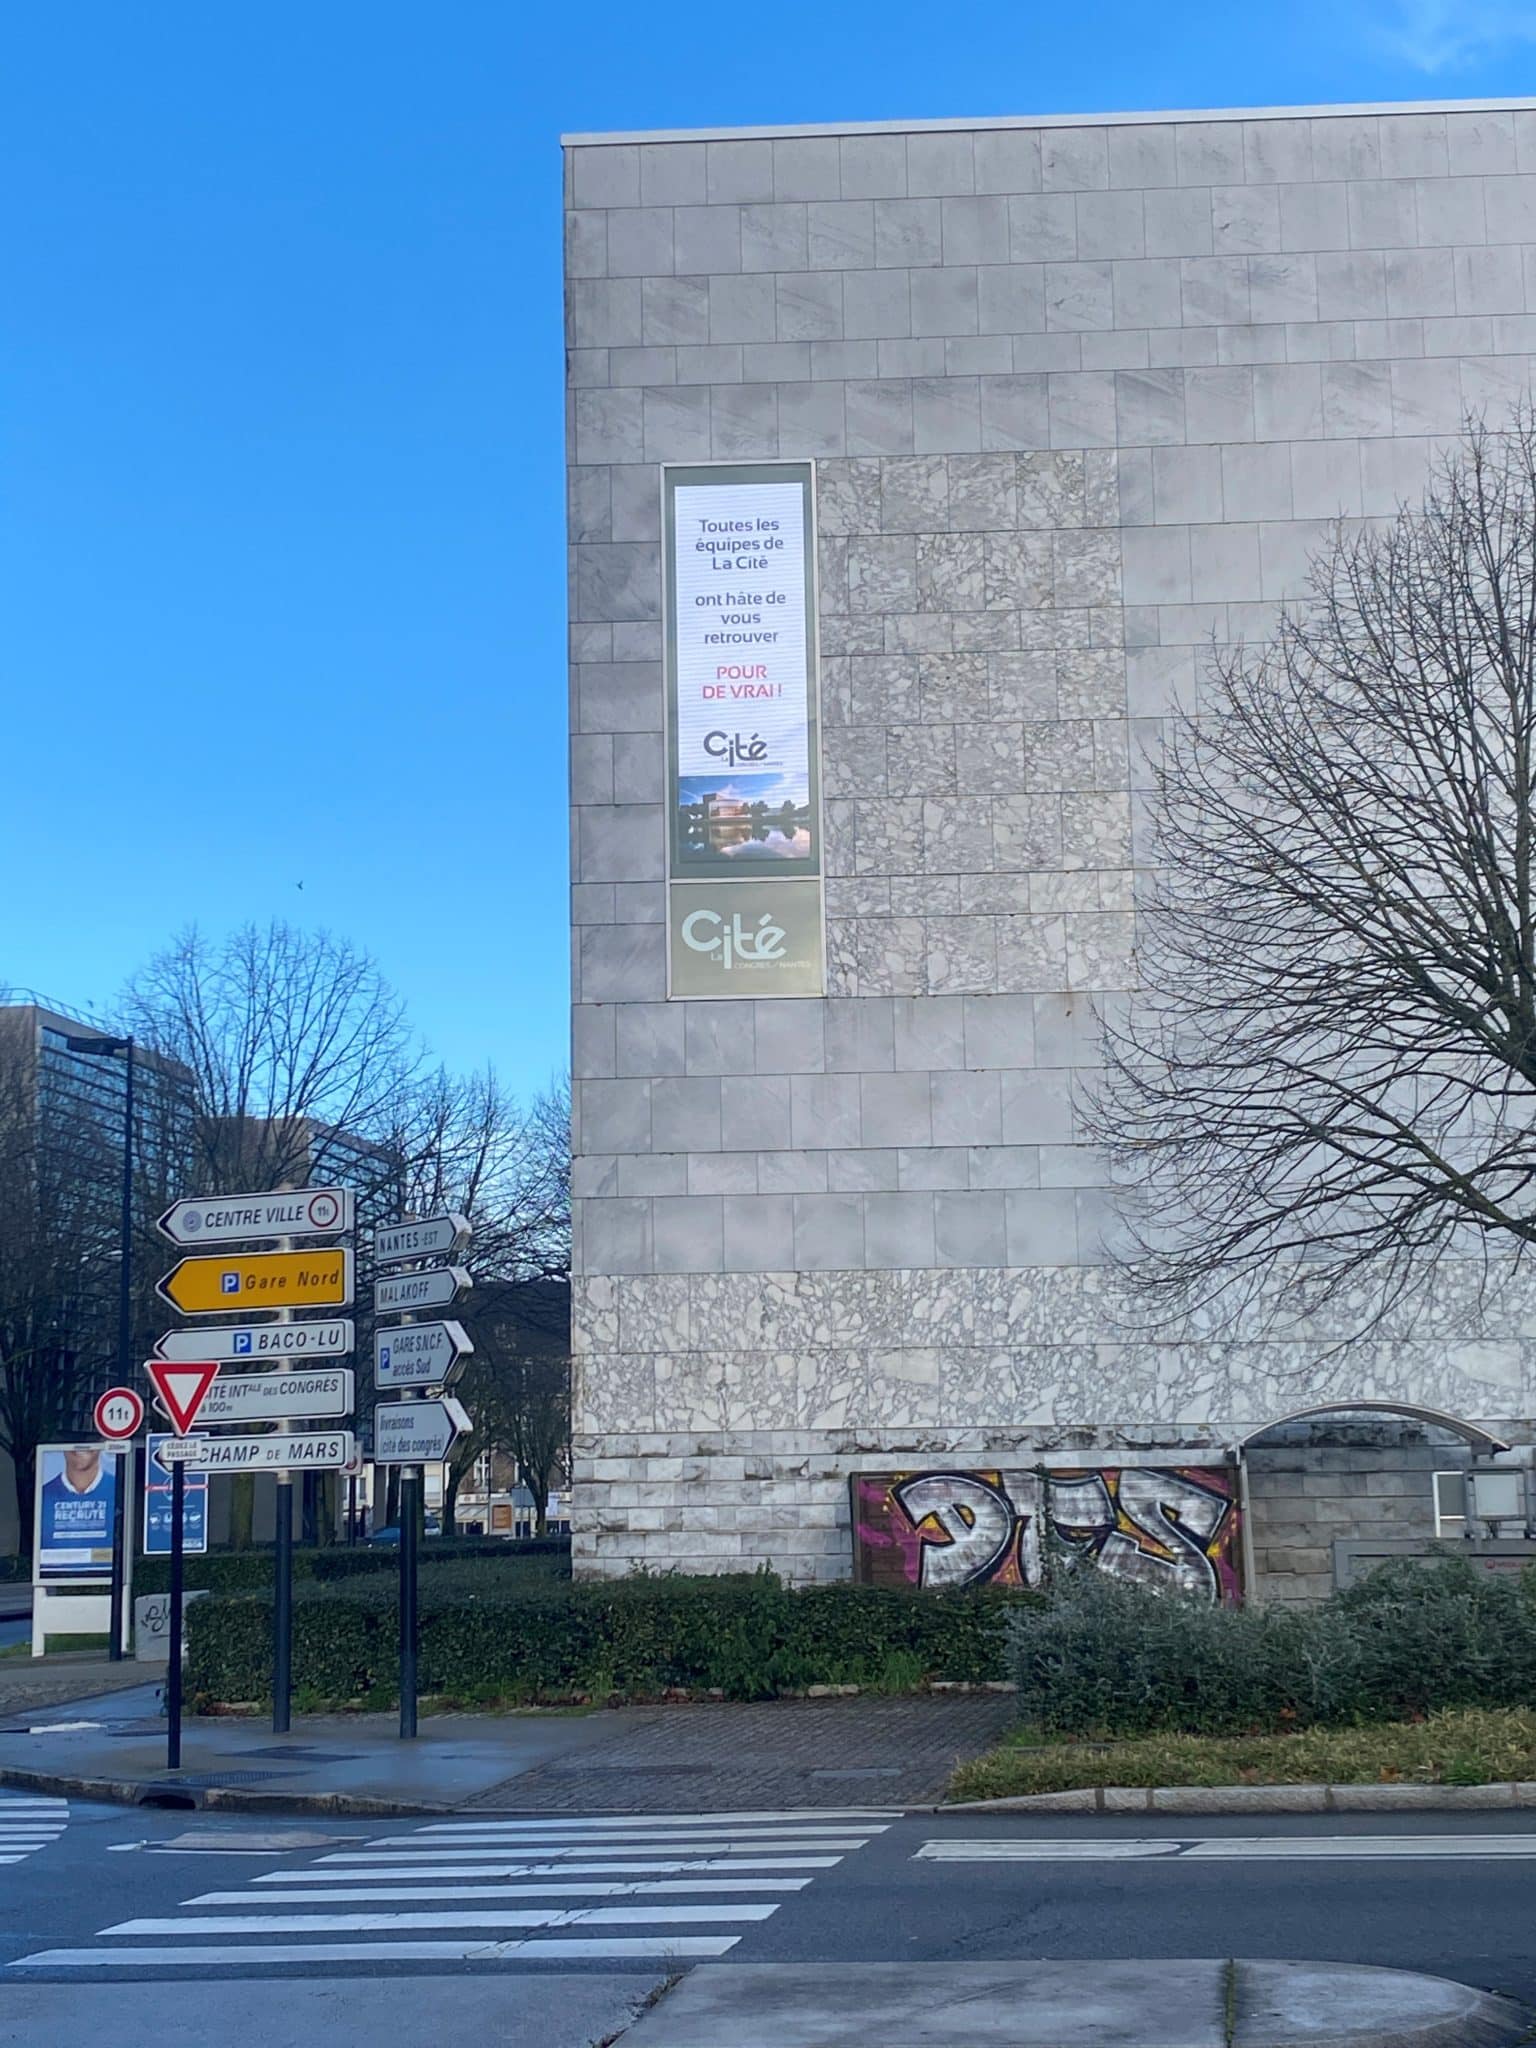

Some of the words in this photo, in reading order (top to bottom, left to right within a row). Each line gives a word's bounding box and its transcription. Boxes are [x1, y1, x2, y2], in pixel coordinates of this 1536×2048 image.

[698, 519, 753, 533] Toutes
[757, 518, 780, 531] les
[695, 537, 761, 554] équipes
[763, 536, 784, 550] de
[712, 556, 732, 570] La
[735, 555, 768, 569] Cité
[695, 594, 722, 606] ont
[725, 591, 763, 606] hâte
[766, 590, 787, 604] de
[720, 613, 761, 624] vous
[704, 631, 779, 644] retrouver
[716, 664, 767, 680] POUR
[702, 685, 726, 699] DE
[730, 683, 773, 698] VRAI
[703, 730, 768, 767] Cité
[682, 909, 787, 969] Cité
[205, 1208, 262, 1228] CENTRE
[266, 1205, 304, 1223] VILLE
[245, 1274, 287, 1290] Gare
[297, 1269, 339, 1287] Nord
[380, 1281, 429, 1303] MALAKOFF
[258, 1329, 340, 1349] BACO-LU
[416, 1355, 432, 1374] Sud
[205, 1383, 227, 1399] ITÉ
[107, 1407, 129, 1420] 11t
[380, 1414, 415, 1431] livraisons
[200, 1445, 260, 1463] CHAMP
[266, 1449, 280, 1460] DE
[288, 1442, 339, 1460] MARS
